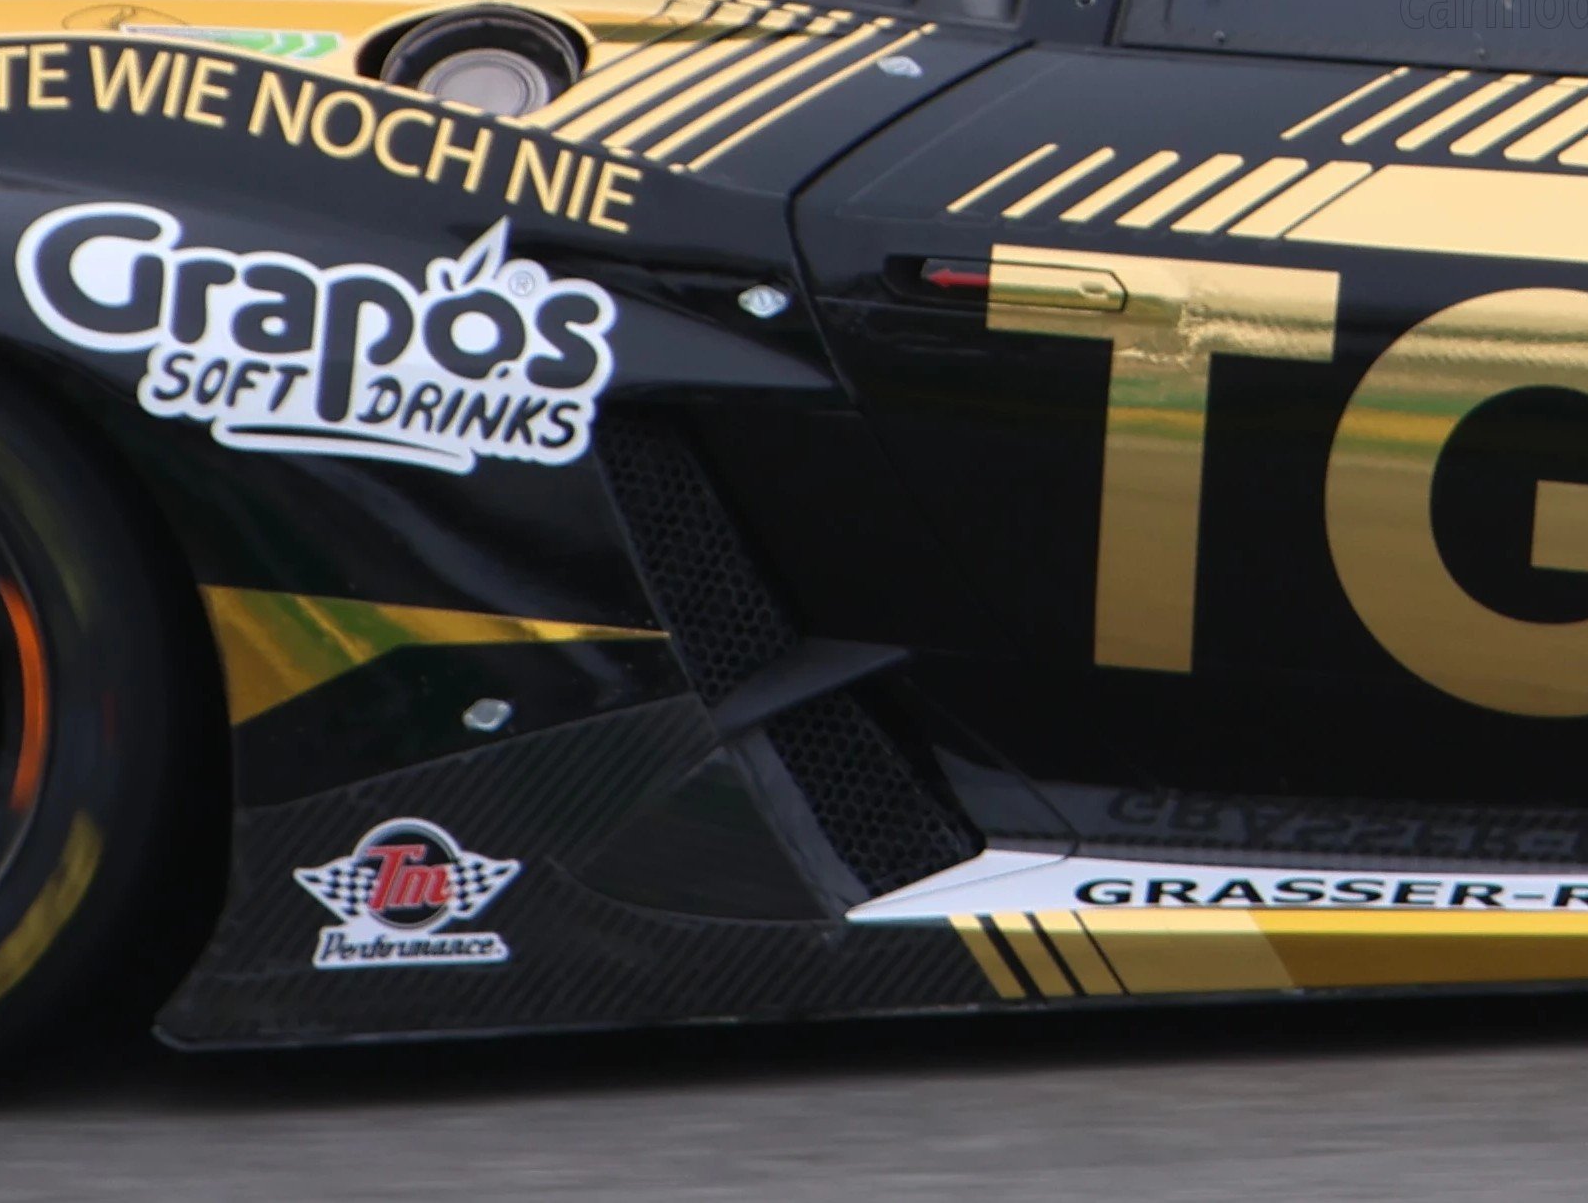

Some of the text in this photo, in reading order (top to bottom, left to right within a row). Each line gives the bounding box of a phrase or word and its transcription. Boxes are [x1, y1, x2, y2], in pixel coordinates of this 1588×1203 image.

[89, 45, 238, 128] WIE
[248, 70, 494, 194] NOCH
[504, 138, 645, 235] NIE
[153, 353, 581, 450] SOFT DRINKS
